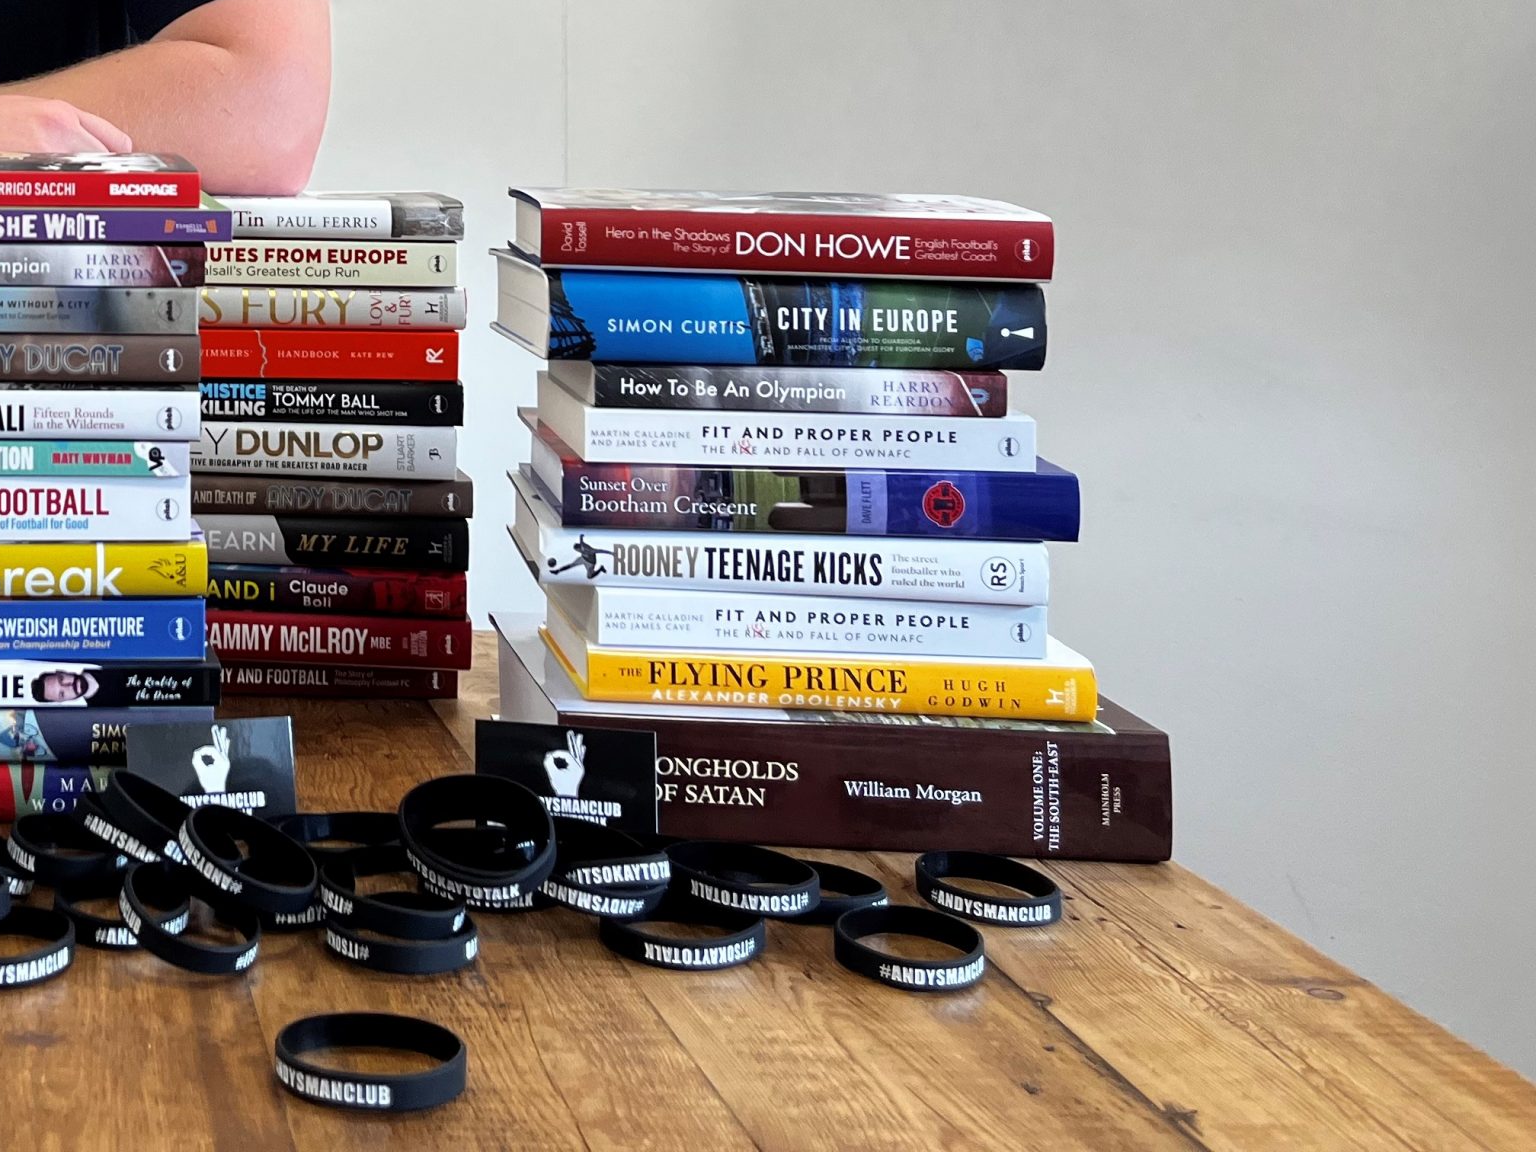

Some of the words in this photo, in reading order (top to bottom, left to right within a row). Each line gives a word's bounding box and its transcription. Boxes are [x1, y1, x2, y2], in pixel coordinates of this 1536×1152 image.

[34, 182, 75, 196] SACCHI
[110, 184, 177, 196] BACKPAGE
[277, 216, 316, 227] PAUL
[323, 216, 378, 228] FERRIS
[735, 232, 807, 256] DON
[815, 234, 910, 260] HOWE
[86, 253, 141, 266] HARRY
[74, 267, 152, 279] REARDON
[607, 317, 672, 334] SIMON
[681, 318, 746, 335] CURTIS
[777, 307, 828, 331] CITY
[840, 309, 860, 332] IN
[872, 310, 958, 333] EUROPE
[277, 350, 339, 359] HANDBOOK
[273, 392, 335, 407] TOMMY
[342, 394, 379, 409] BALL
[236, 428, 383, 459] DUNLOP
[702, 426, 731, 440] FIT
[742, 427, 782, 440] AND
[794, 428, 872, 442] PROPER
[882, 430, 957, 443] PEOPLE
[580, 476, 624, 492] Sunset
[630, 478, 667, 494] Over
[581, 494, 667, 513] Bootham
[673, 498, 757, 517] Crescent
[297, 534, 336, 551] MY
[345, 536, 409, 555] LIFE
[289, 580, 348, 595] Claude
[303, 597, 331, 608] Boli
[280, 627, 367, 654] McILROY
[371, 637, 391, 649] MBE
[237, 668, 262, 684] AND
[267, 670, 328, 685] FOOTBALL
[647, 661, 767, 690] FLYING
[782, 663, 907, 694] PRINCE
[944, 678, 1006, 693] HUGH
[928, 695, 1021, 709] GODWIN
[844, 780, 910, 800] William
[916, 783, 982, 805] Morgan
[1048, 741, 1059, 824] SOUTH-EAST
[685, 783, 765, 806] SATAN
[1033, 774, 1043, 841] VOLUME
[1049, 826, 1059, 852] THE
[690, 879, 808, 912] #ITSOKAYTOTALK
[931, 889, 1051, 922] #ANDYSMANCLUB
[644, 937, 755, 965] #ITSOKAYTOTALK
